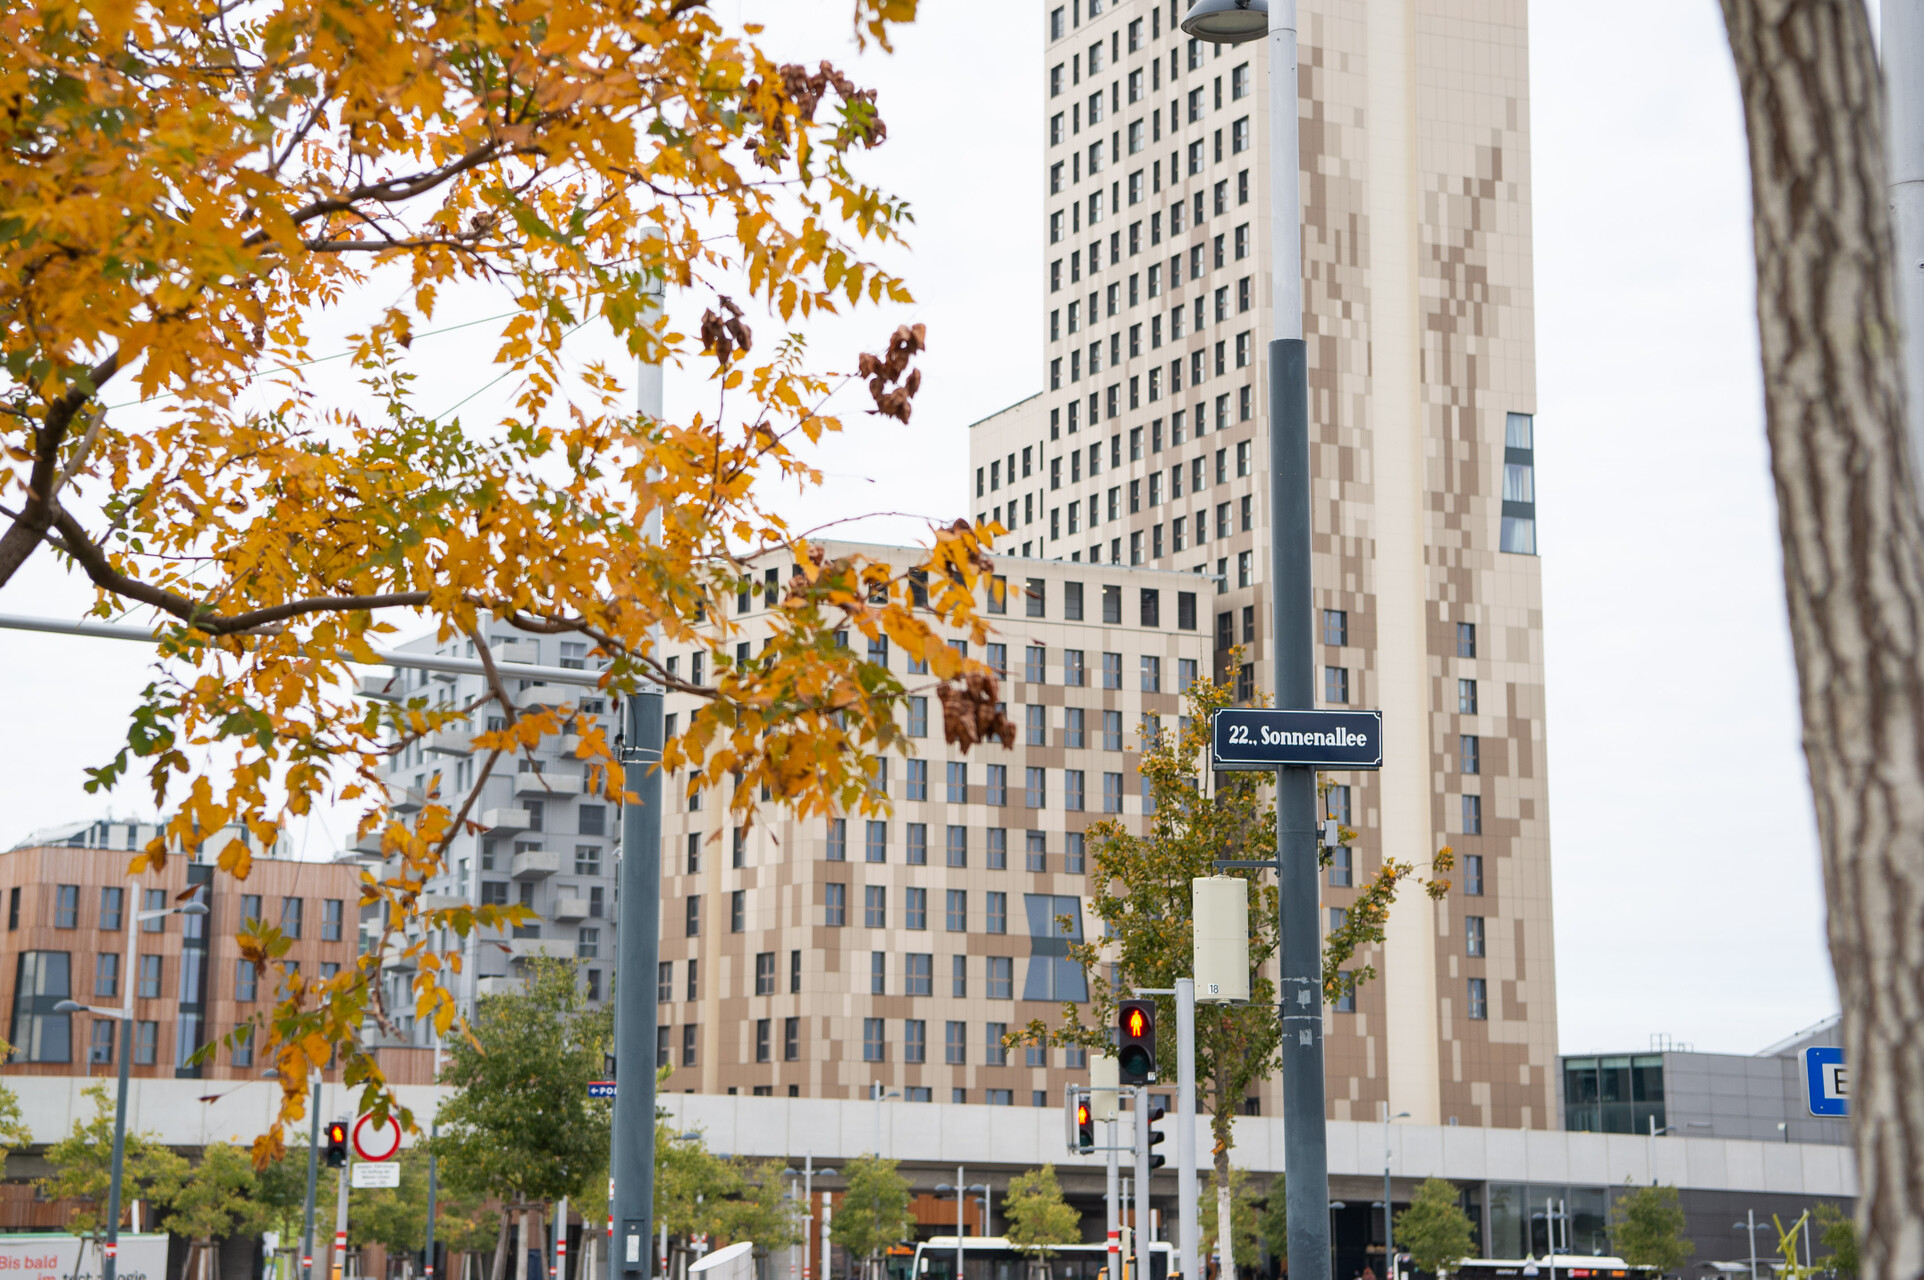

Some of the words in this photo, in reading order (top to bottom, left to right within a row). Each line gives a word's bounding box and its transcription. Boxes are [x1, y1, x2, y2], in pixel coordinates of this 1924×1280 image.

[1228, 725, 1257, 746] 22.,
[1261, 725, 1368, 747] Sonnenallee
[1210, 984, 1219, 994] 18
[0, 1255, 21, 1270] Bis
[24, 1255, 58, 1270] bald
